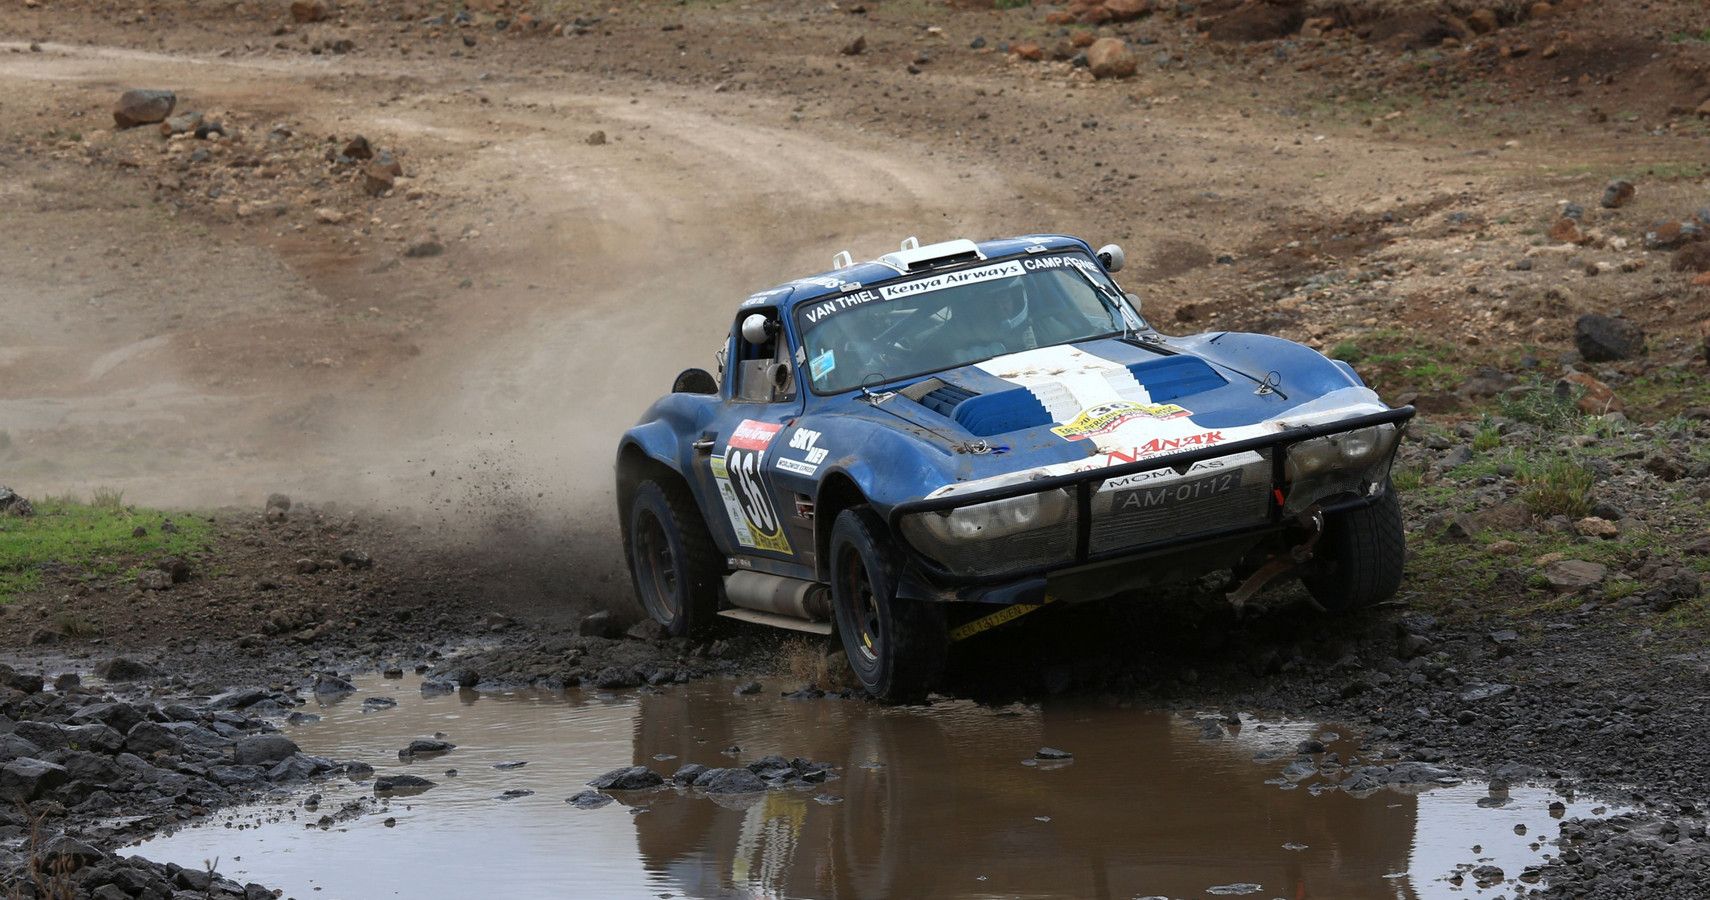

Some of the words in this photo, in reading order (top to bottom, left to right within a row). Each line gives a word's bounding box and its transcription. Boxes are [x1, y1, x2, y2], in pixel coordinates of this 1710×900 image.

[886, 277, 942, 297] Kenya
[945, 264, 1019, 284] Airways
[805, 301, 837, 324] VAN
[835, 290, 880, 314] THIEL
[1091, 403, 1130, 416] 36
[789, 427, 822, 451] SKY
[805, 447, 830, 464] NET
[1106, 430, 1226, 467] NANAK
[730, 450, 775, 531] 36
[1120, 474, 1231, 510] AM-01-12
